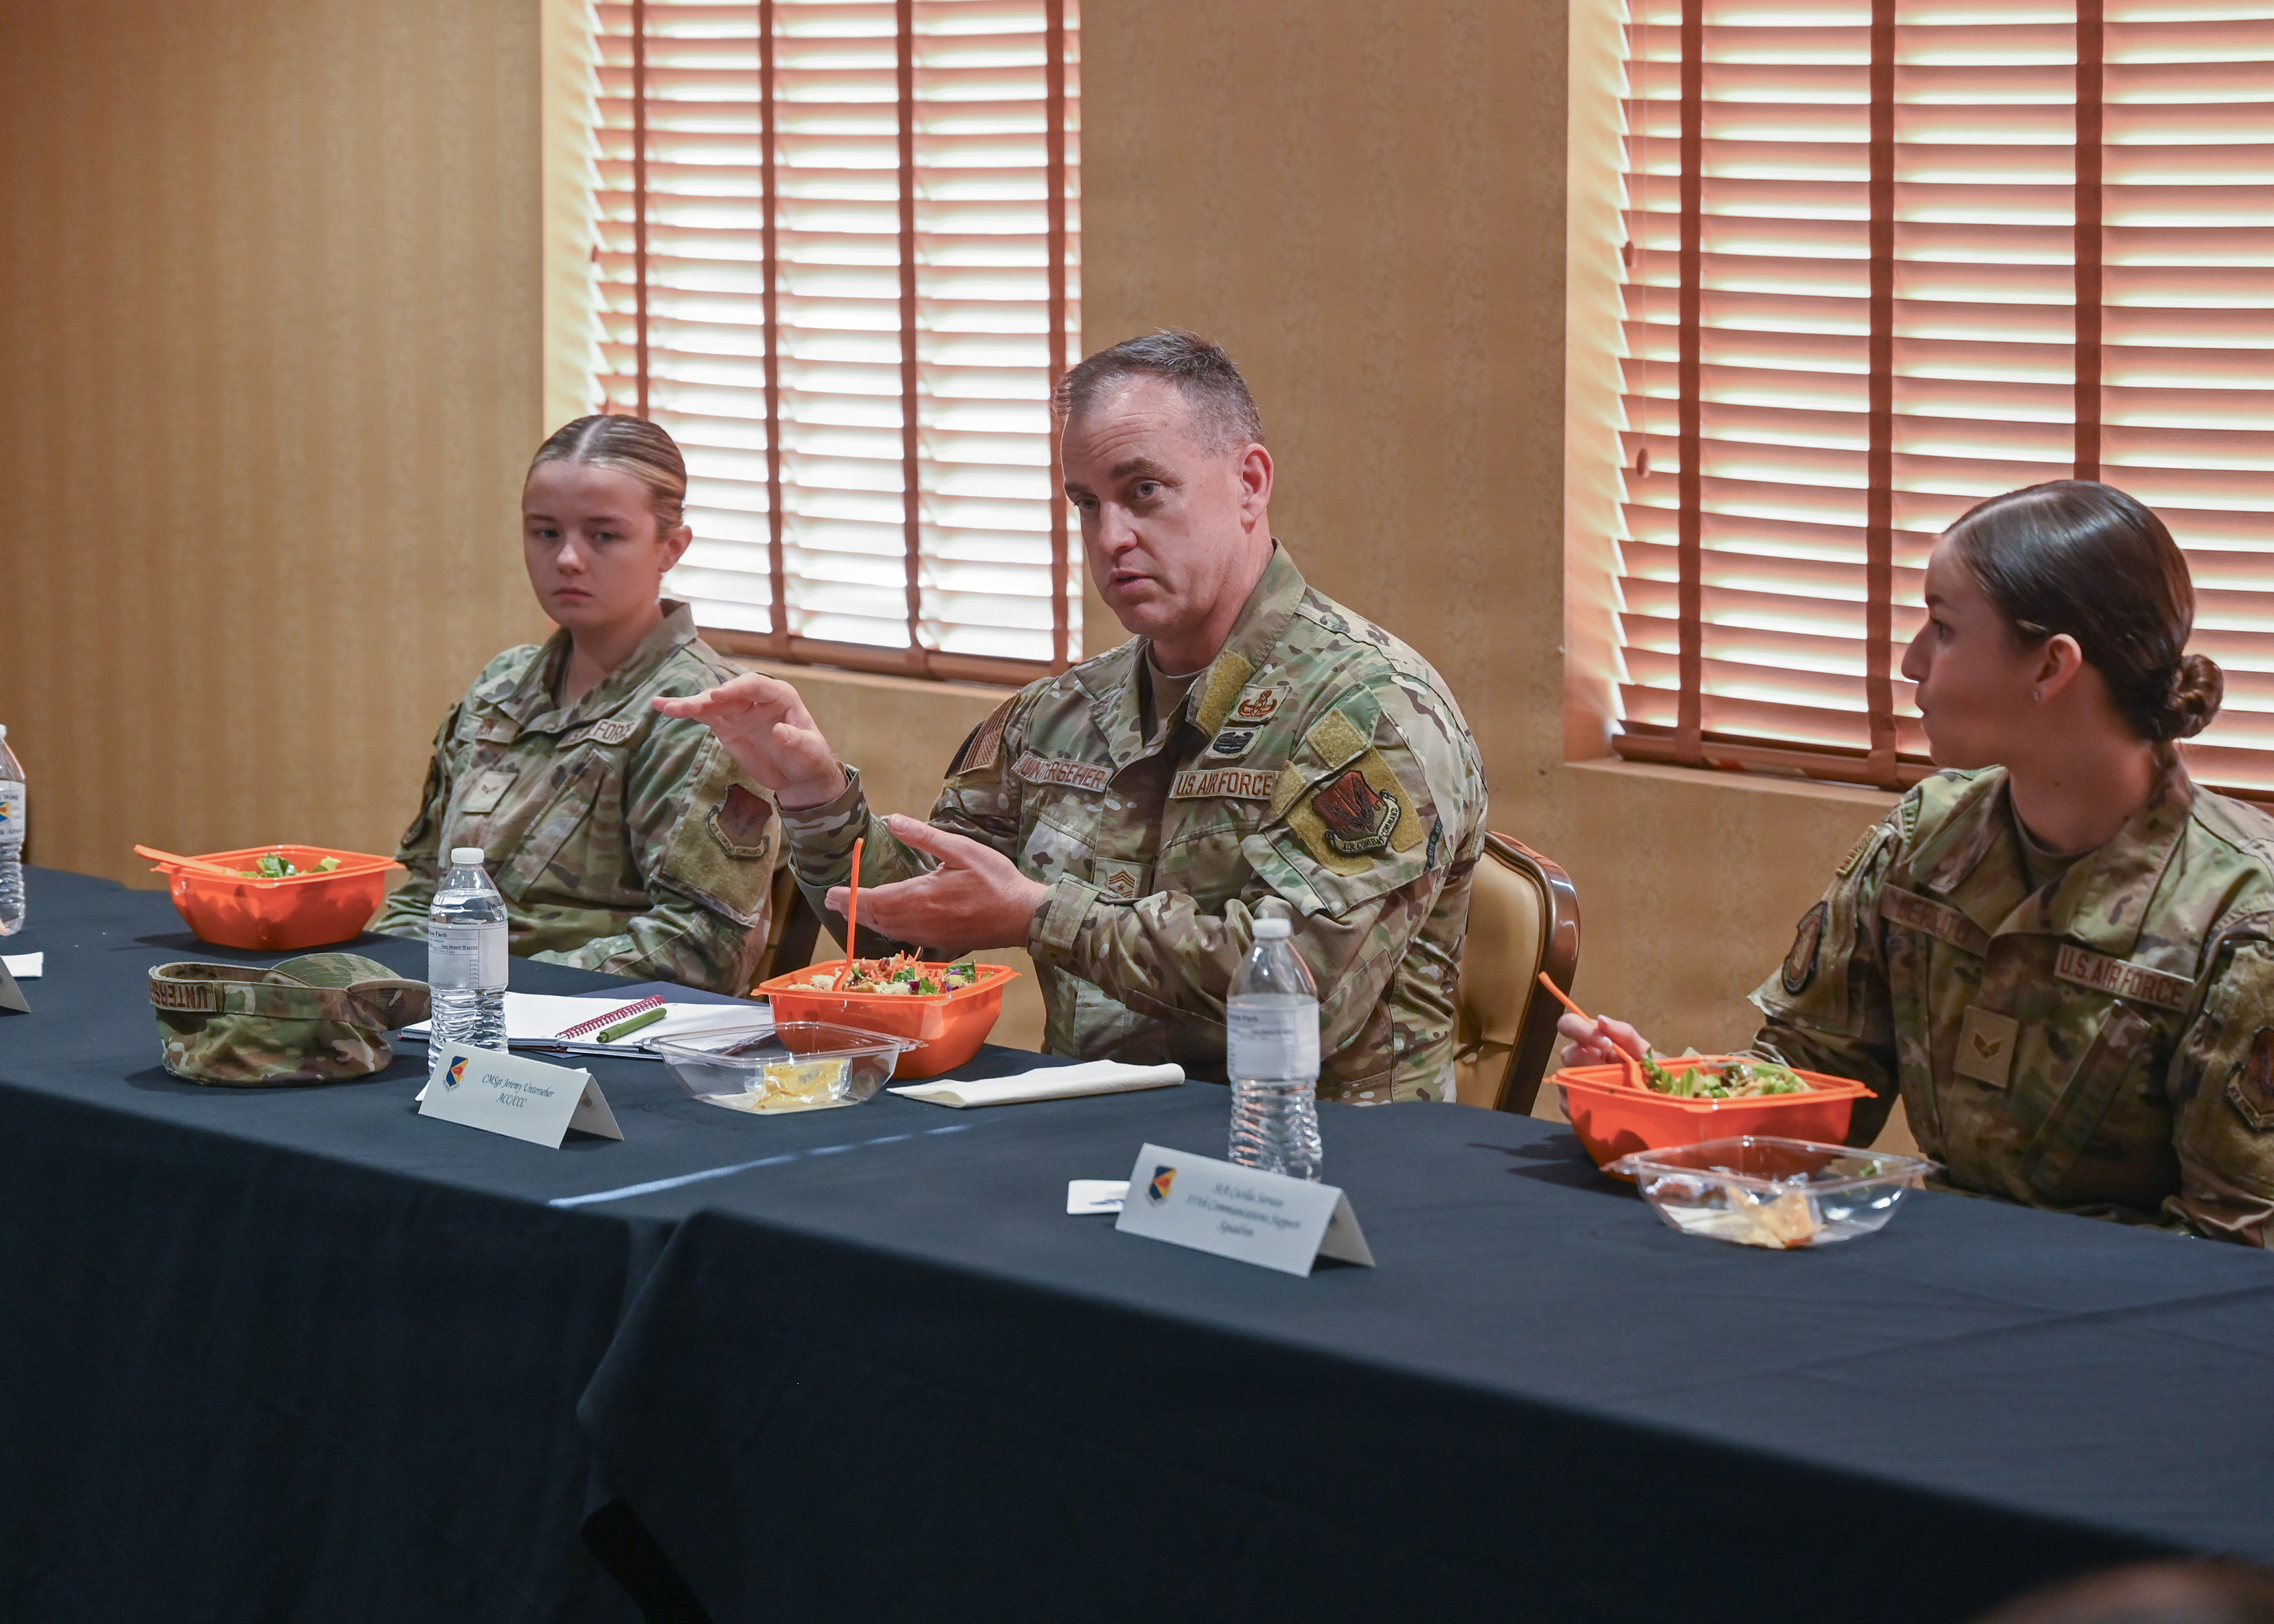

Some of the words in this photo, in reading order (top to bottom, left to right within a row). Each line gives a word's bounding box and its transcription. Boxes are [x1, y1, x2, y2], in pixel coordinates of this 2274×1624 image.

[1197, 773, 1219, 794] AIR
[1218, 772, 1273, 796] FORCE
[1342, 843, 1355, 851] AIR
[1381, 808, 1398, 837] COMMAND
[2089, 958, 2123, 987] AIR
[2120, 968, 2186, 1007] FORCE
[482, 1073, 503, 1088] CMSgt
[501, 1078, 523, 1093] Jeremy
[523, 1082, 555, 1098] Unterseher
[496, 1093, 527, 1108] ACC/CCC
